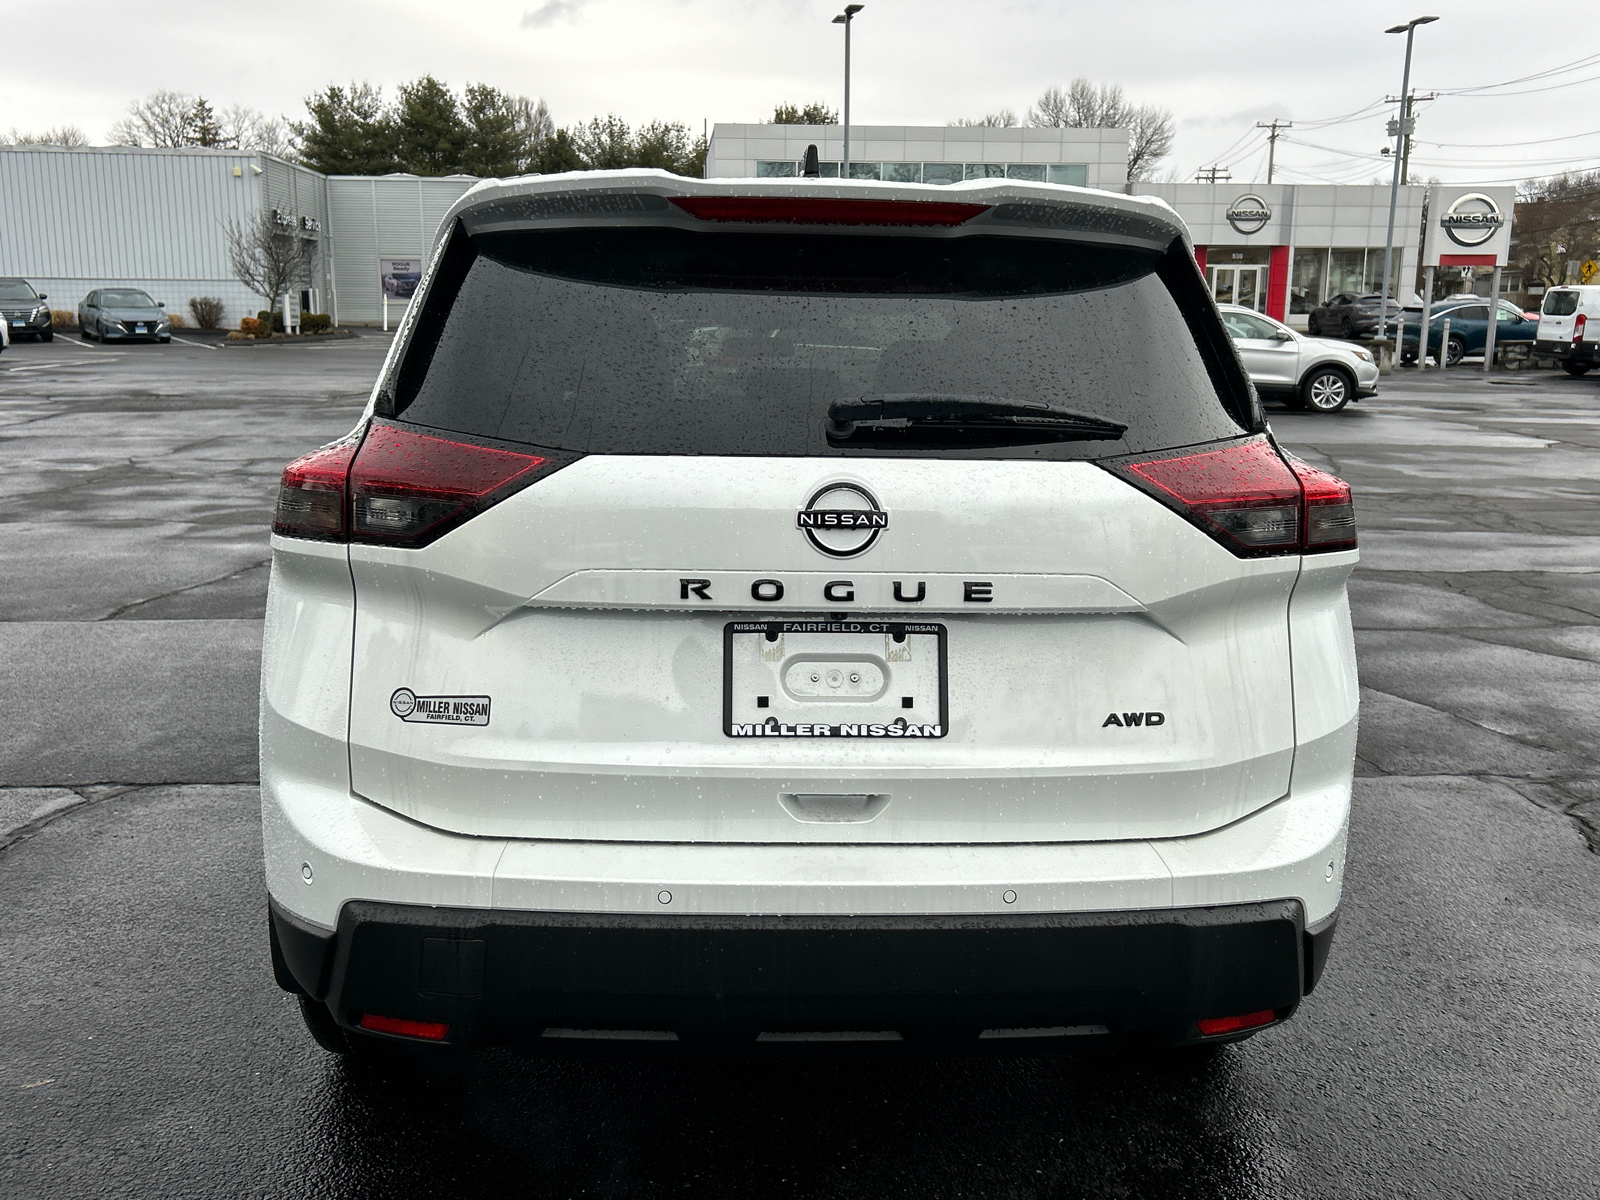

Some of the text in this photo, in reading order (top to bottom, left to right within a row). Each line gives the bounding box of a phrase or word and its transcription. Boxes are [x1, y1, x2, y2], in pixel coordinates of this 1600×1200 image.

[1448, 215, 1499, 224] NISSAN
[800, 513, 887, 526] NISSAN
[679, 578, 994, 602] ROGUE
[783, 623, 890, 633] FAIRFIELD, CT
[416, 700, 488, 716] MILLER NISSAN
[426, 713, 462, 722] FAIRFIELD,
[1101, 712, 1165, 727] AWD
[731, 724, 942, 737] MILLER NISSAN
